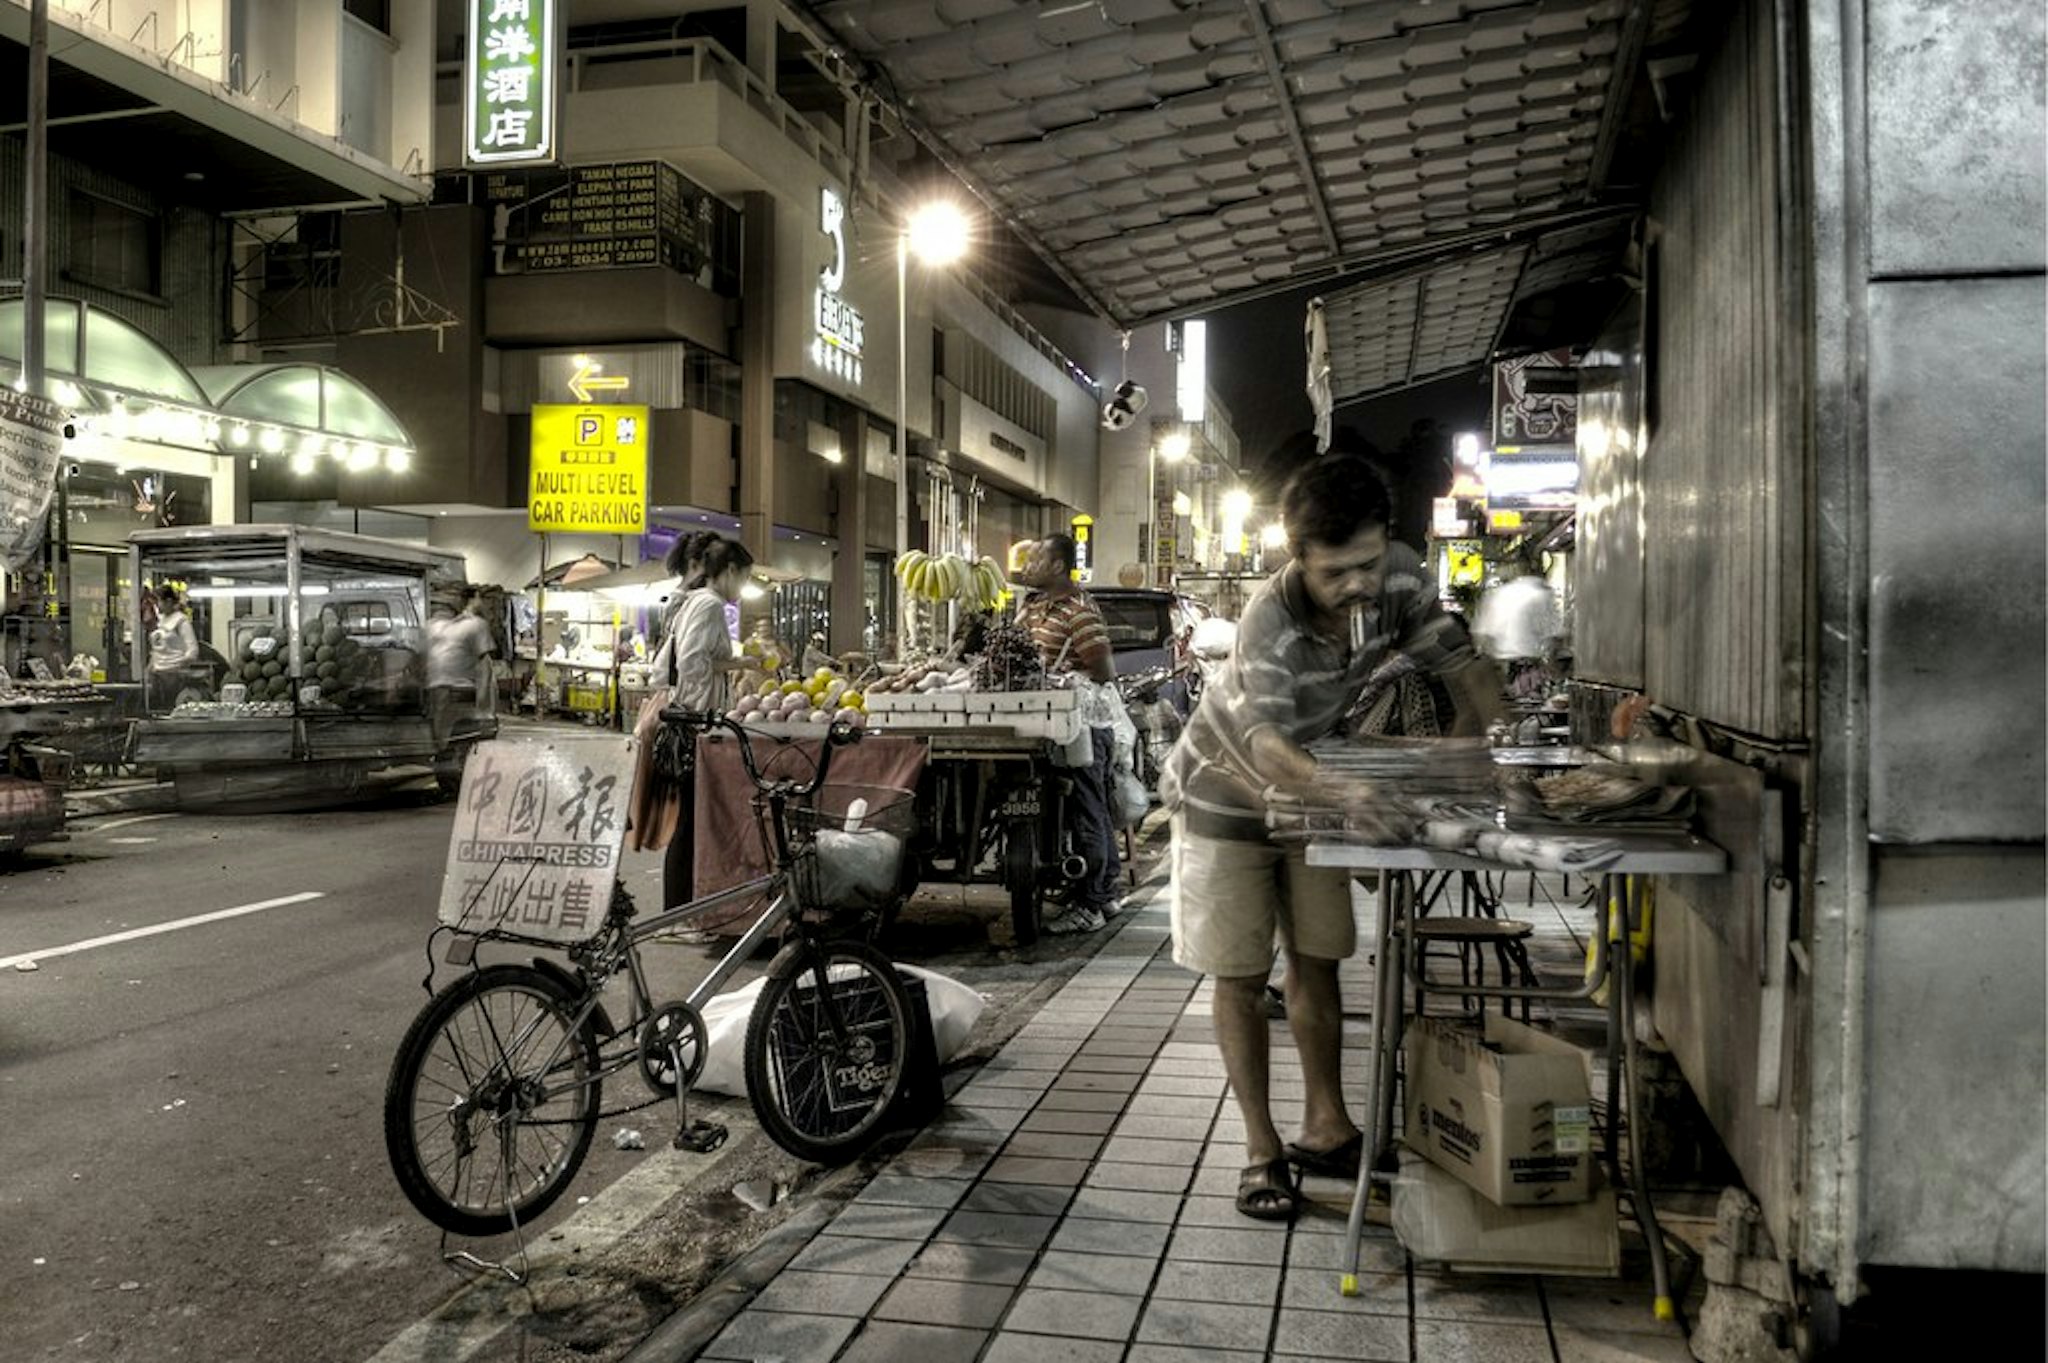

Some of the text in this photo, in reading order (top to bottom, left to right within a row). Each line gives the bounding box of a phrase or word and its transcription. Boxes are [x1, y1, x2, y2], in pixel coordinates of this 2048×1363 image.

[616, 165, 655, 178] NEGARA
[536, 472, 638, 496] MULTI LEVEL
[532, 500, 641, 525] CAR PARKING
[459, 841, 610, 868] CHINA PRESS
[458, 873, 594, 929] 在此出售
